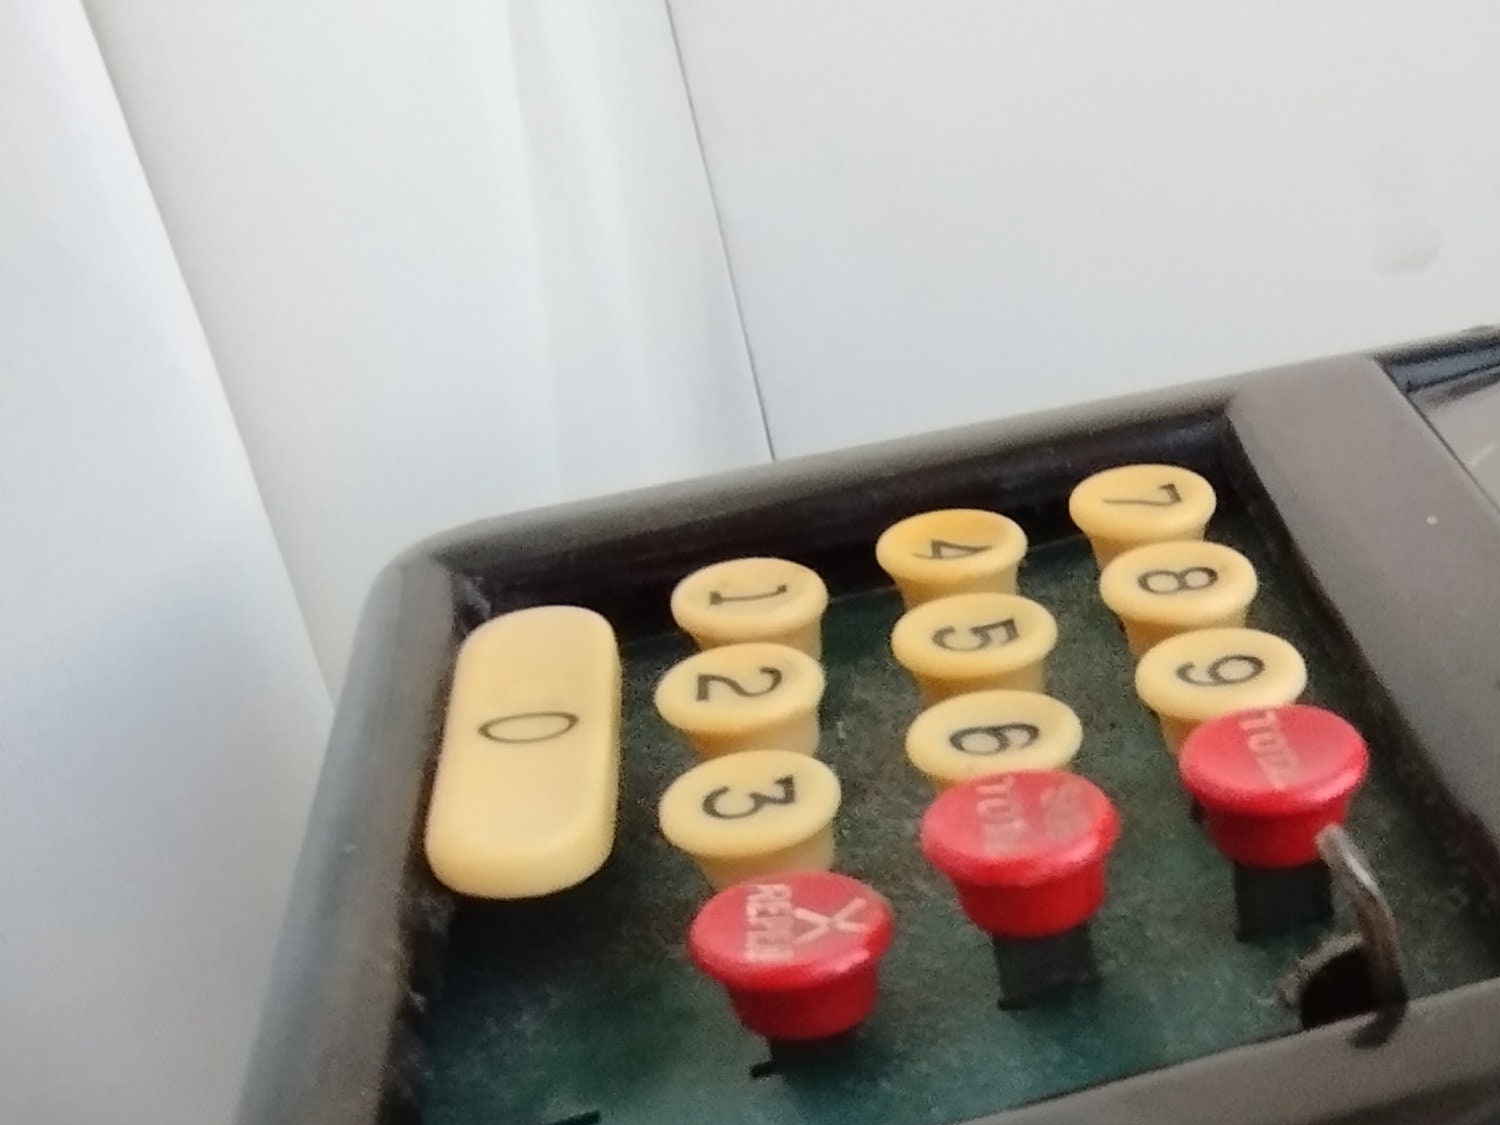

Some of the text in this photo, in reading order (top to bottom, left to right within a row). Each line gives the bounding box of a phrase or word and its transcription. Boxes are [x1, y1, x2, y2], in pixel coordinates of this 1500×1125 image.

[1102, 483, 1183, 508] 7
[911, 538, 992, 561] 4
[708, 583, 788, 606] 1
[1137, 565, 1219, 596] 8
[931, 617, 1020, 653] 5
[695, 666, 783, 702] 2
[1175, 653, 1266, 689] 9
[476, 710, 580, 744] 0
[948, 721, 1041, 757] 6
[702, 774, 797, 820] 3
